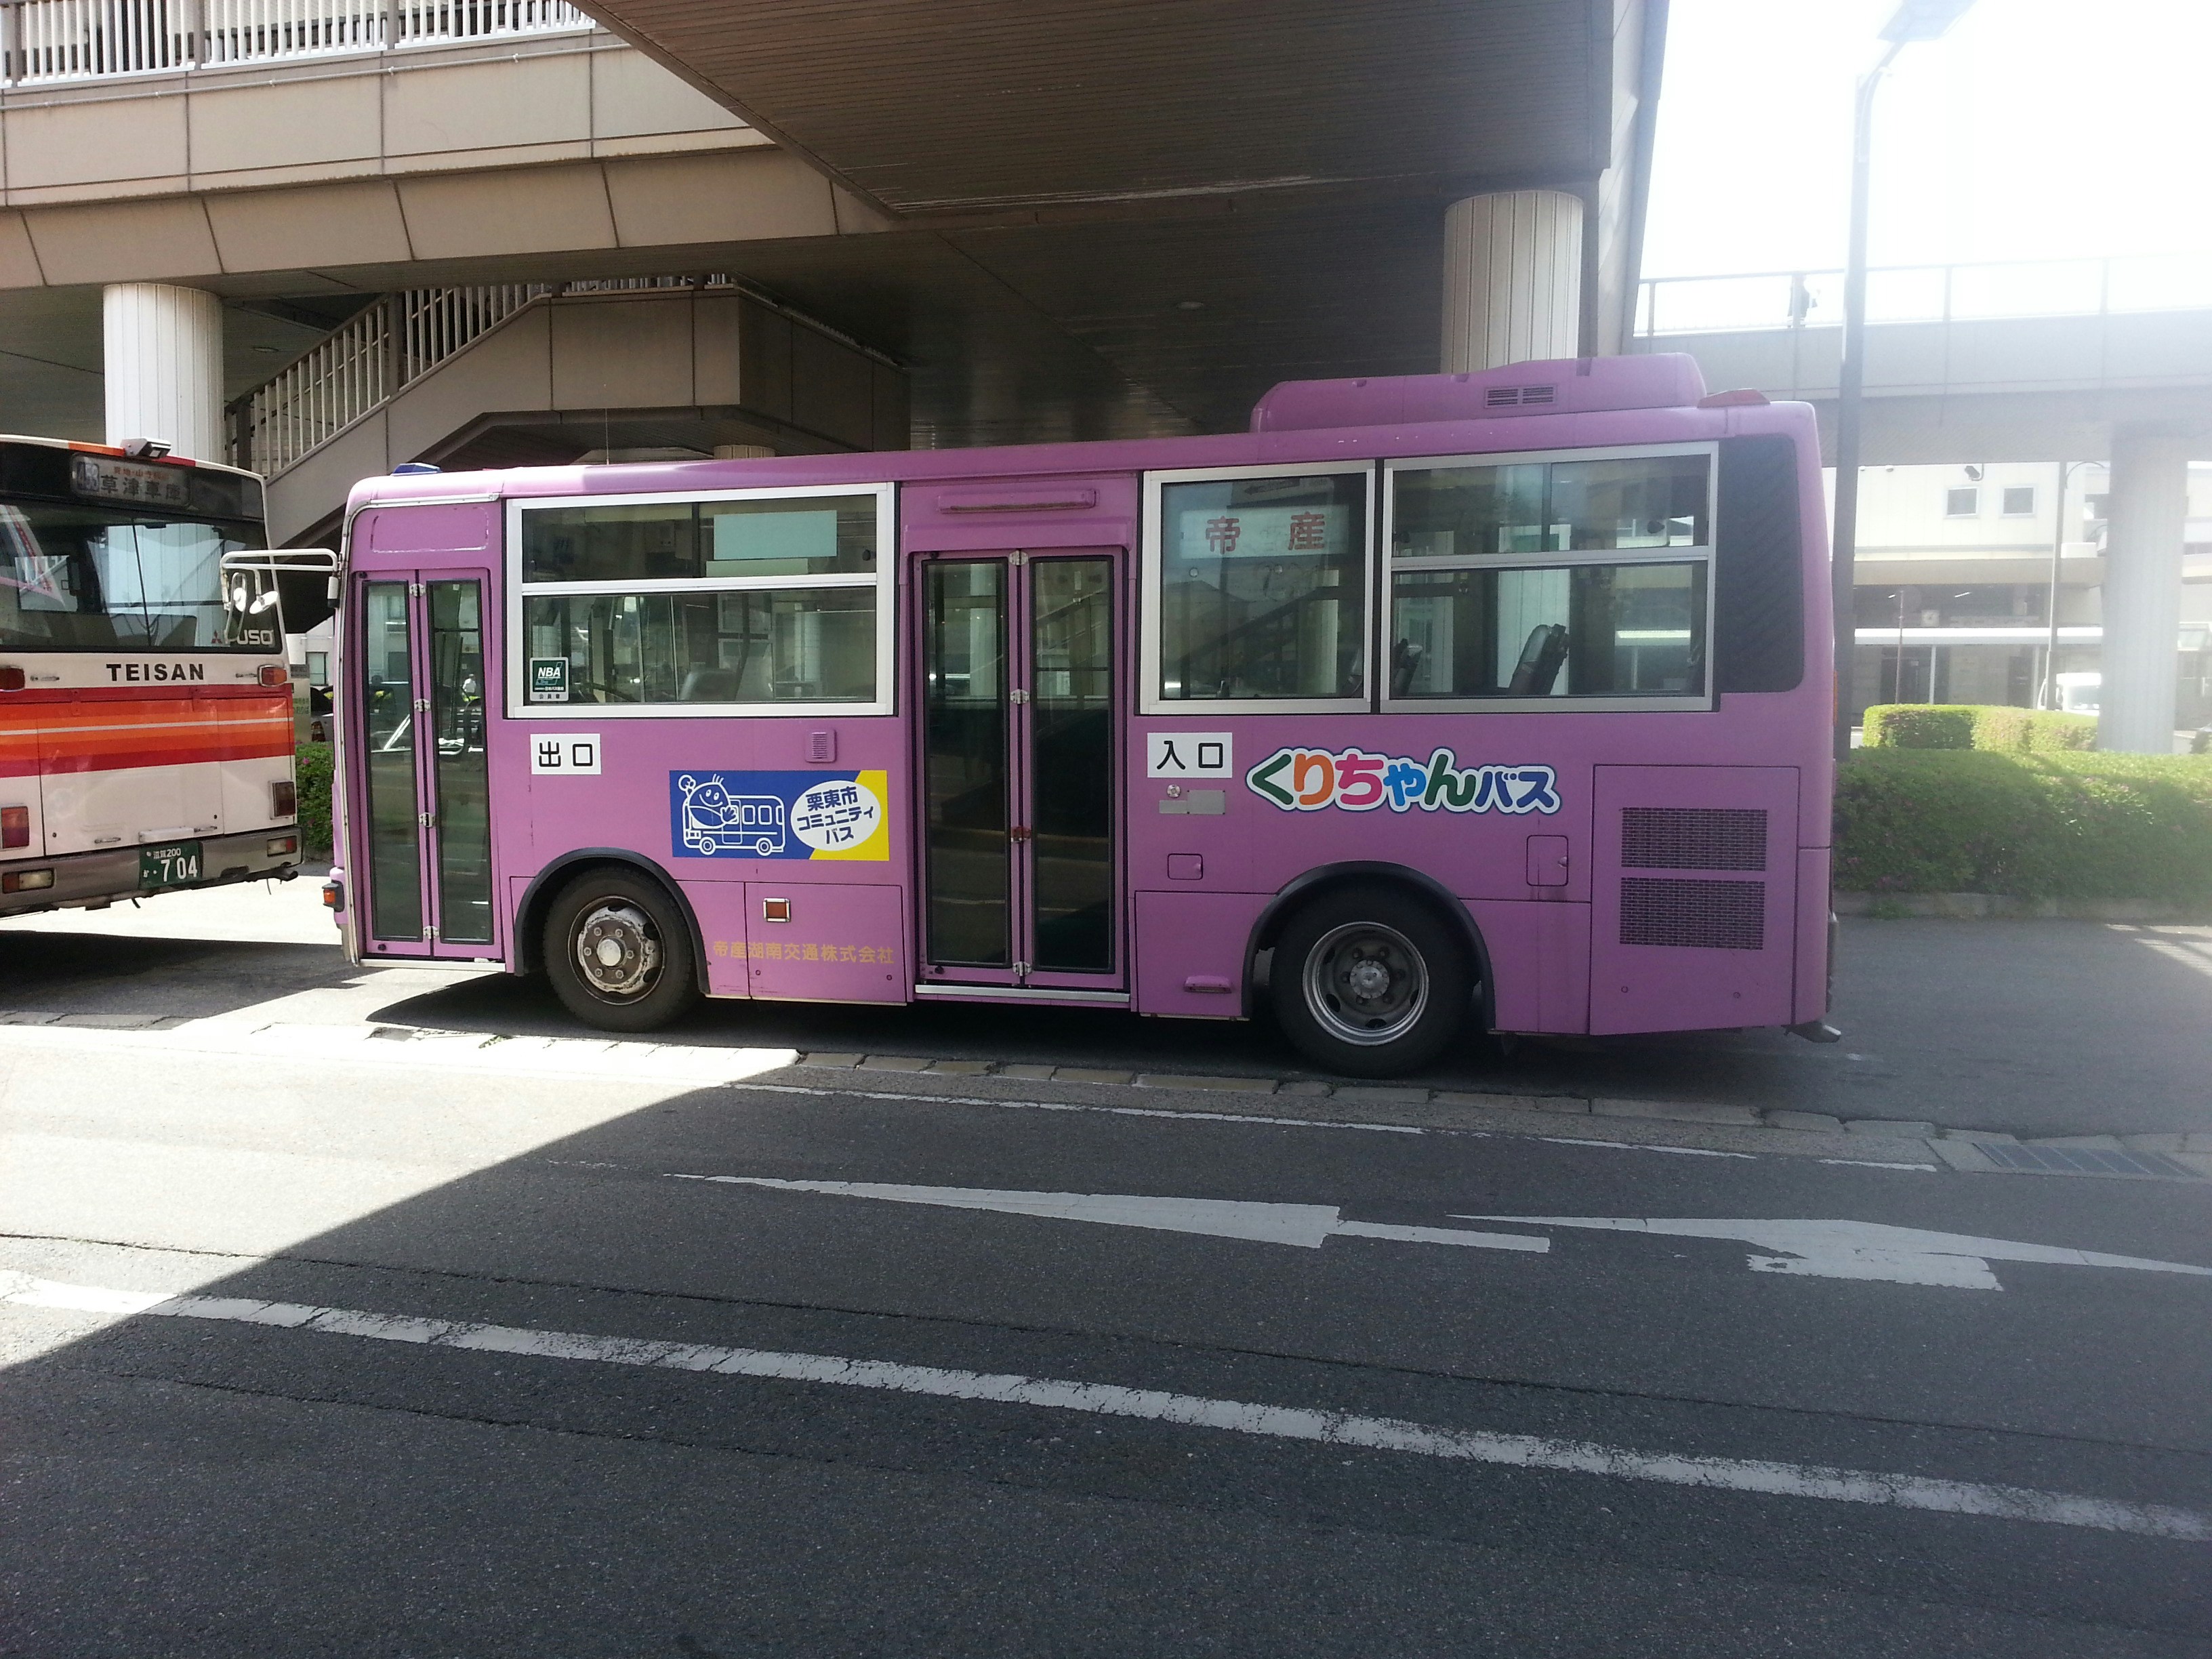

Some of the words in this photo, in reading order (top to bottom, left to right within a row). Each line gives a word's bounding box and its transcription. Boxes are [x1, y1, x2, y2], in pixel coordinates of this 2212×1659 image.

[106, 663, 204, 682] TEISAN
[537, 667, 561, 677] NBA
[539, 741, 593, 767] 出口
[1156, 740, 1223, 770] 入口
[1250, 752, 1555, 808] くりちゃんバス
[805, 786, 859, 812] 栗東市
[796, 806, 874, 832] コミュニティ
[825, 826, 855, 844] バス
[714, 941, 894, 964] 帝産湖南交通株式会社
